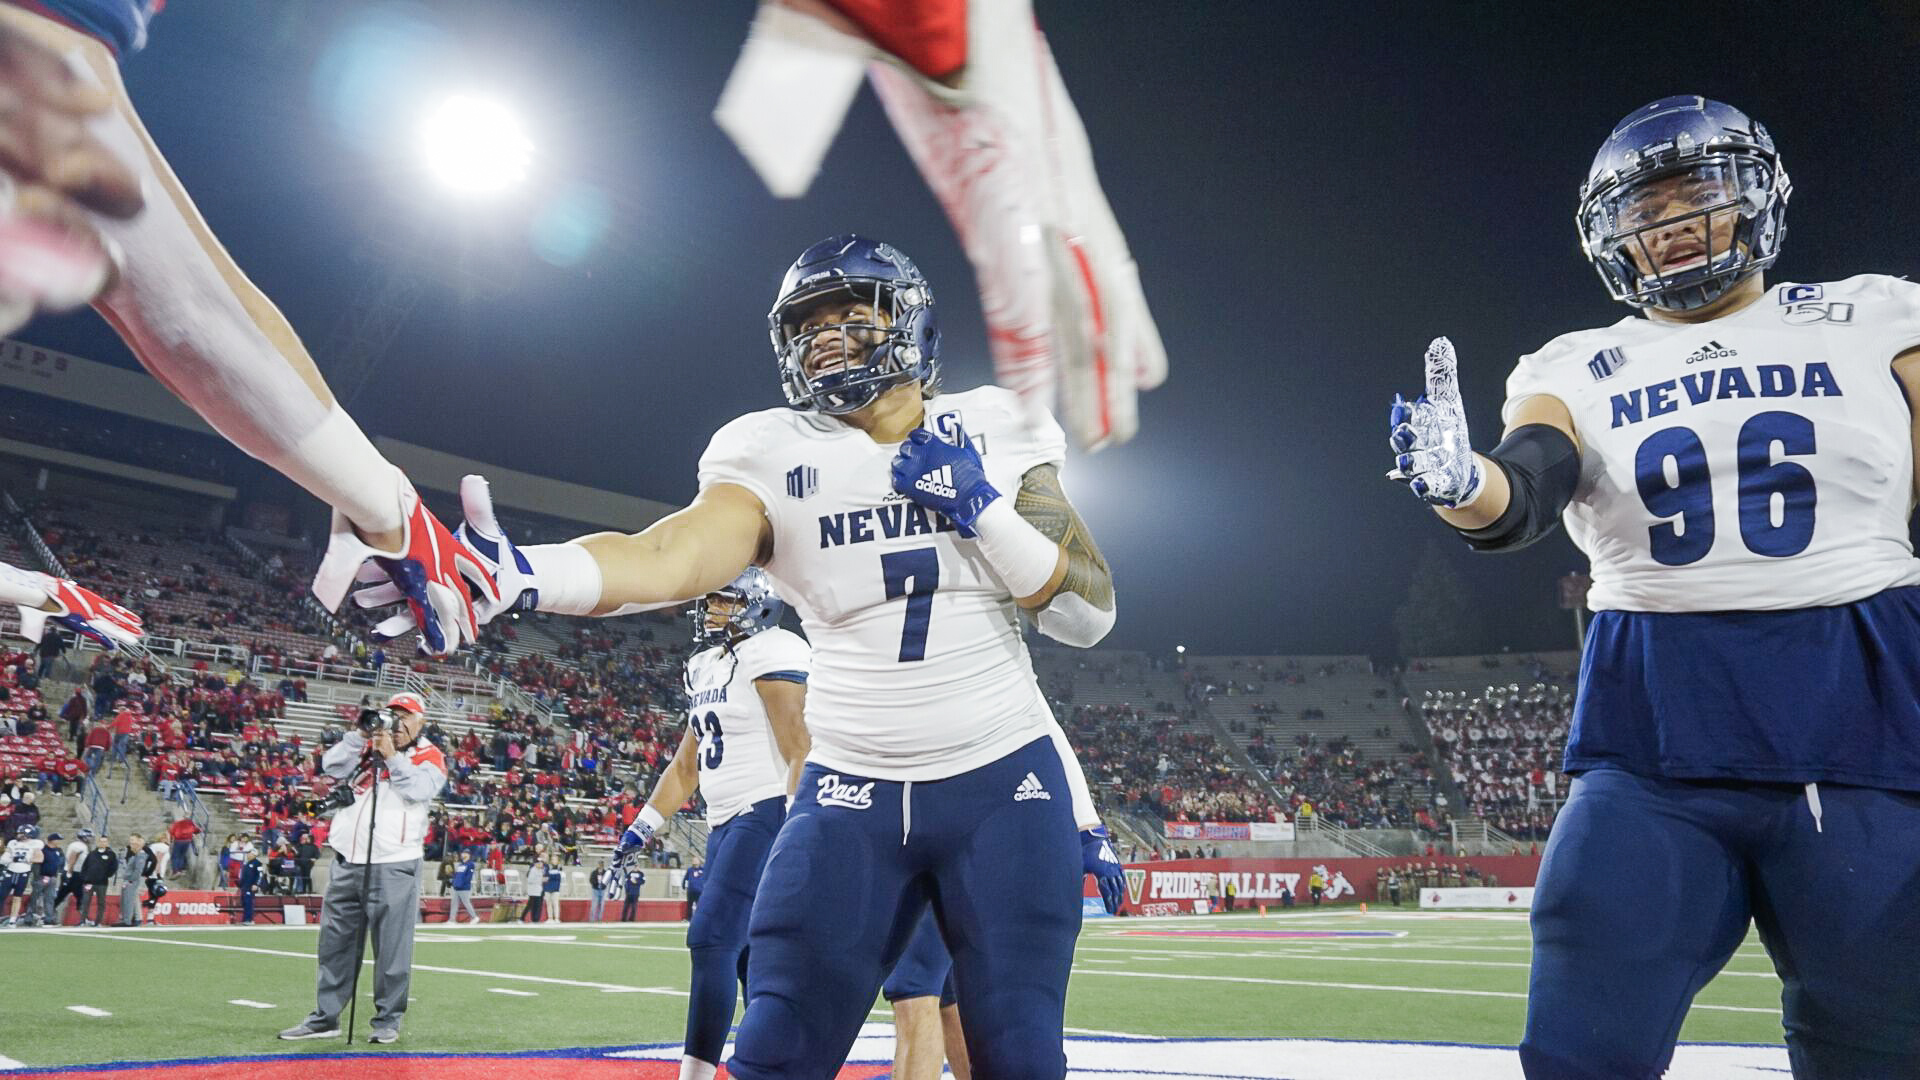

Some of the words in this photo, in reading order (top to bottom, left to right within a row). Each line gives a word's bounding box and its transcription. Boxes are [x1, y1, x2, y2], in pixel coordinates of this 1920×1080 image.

[1685, 348, 1738, 365] adidas
[1611, 361, 1843, 430] NEVADA
[914, 479, 958, 499] adidas
[1634, 410, 1817, 566] 96
[880, 546, 940, 663] 7
[816, 774, 875, 806] Pack
[1013, 789, 1052, 802] adidas
[1150, 871, 1203, 898] PRIDE
